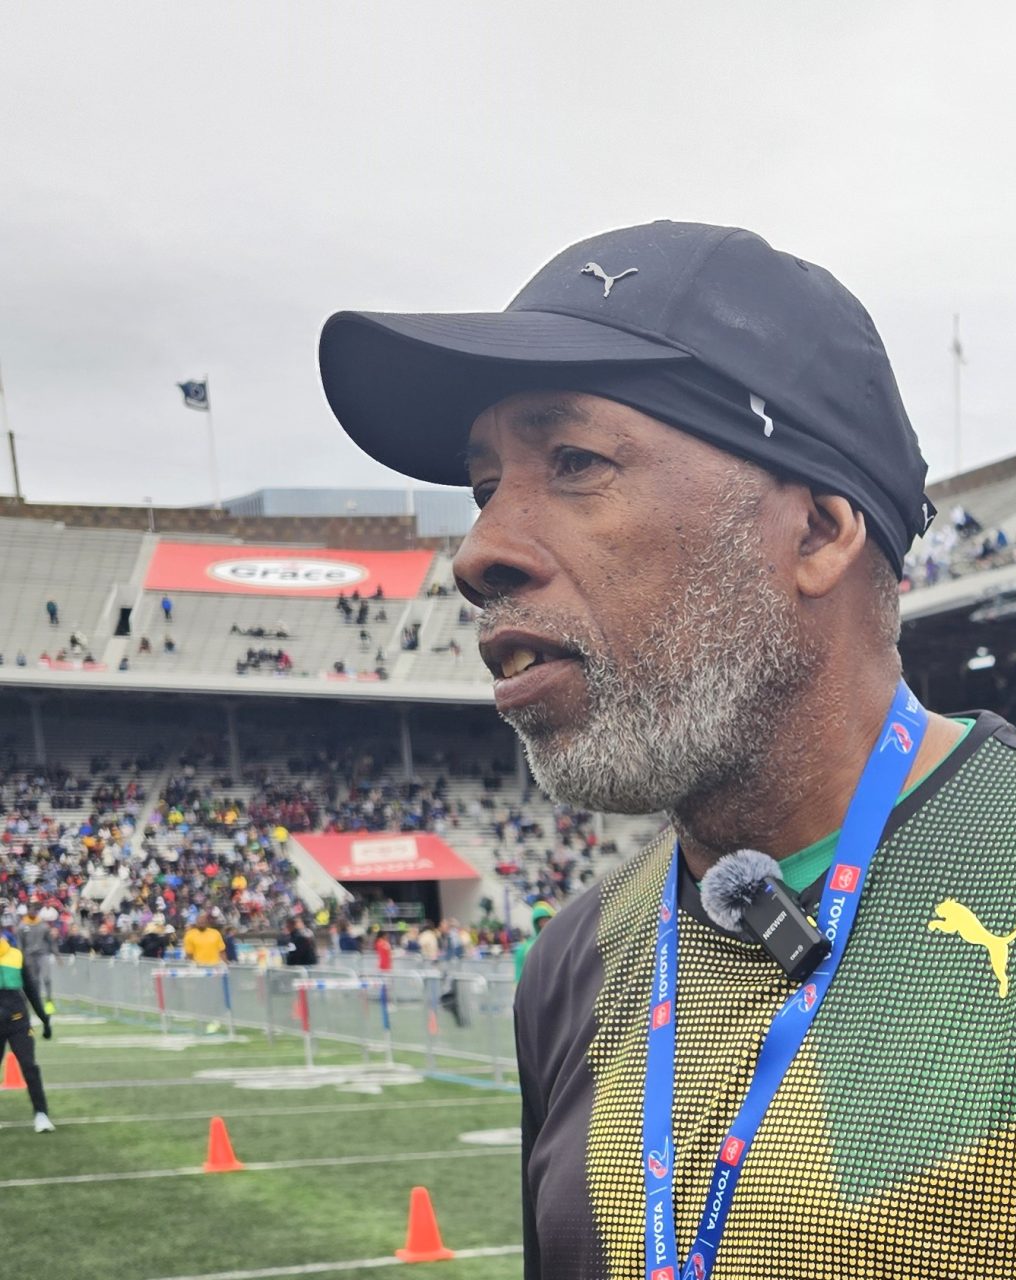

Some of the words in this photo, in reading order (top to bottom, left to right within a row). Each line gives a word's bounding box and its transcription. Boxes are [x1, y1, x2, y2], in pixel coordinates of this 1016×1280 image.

[230, 563, 347, 581] Grace
[823, 896, 846, 960] TOYO
[658, 943, 669, 1002] TOYOTA
[707, 1169, 731, 1230] TOYOTA
[653, 1201, 667, 1265] TOYOTA
